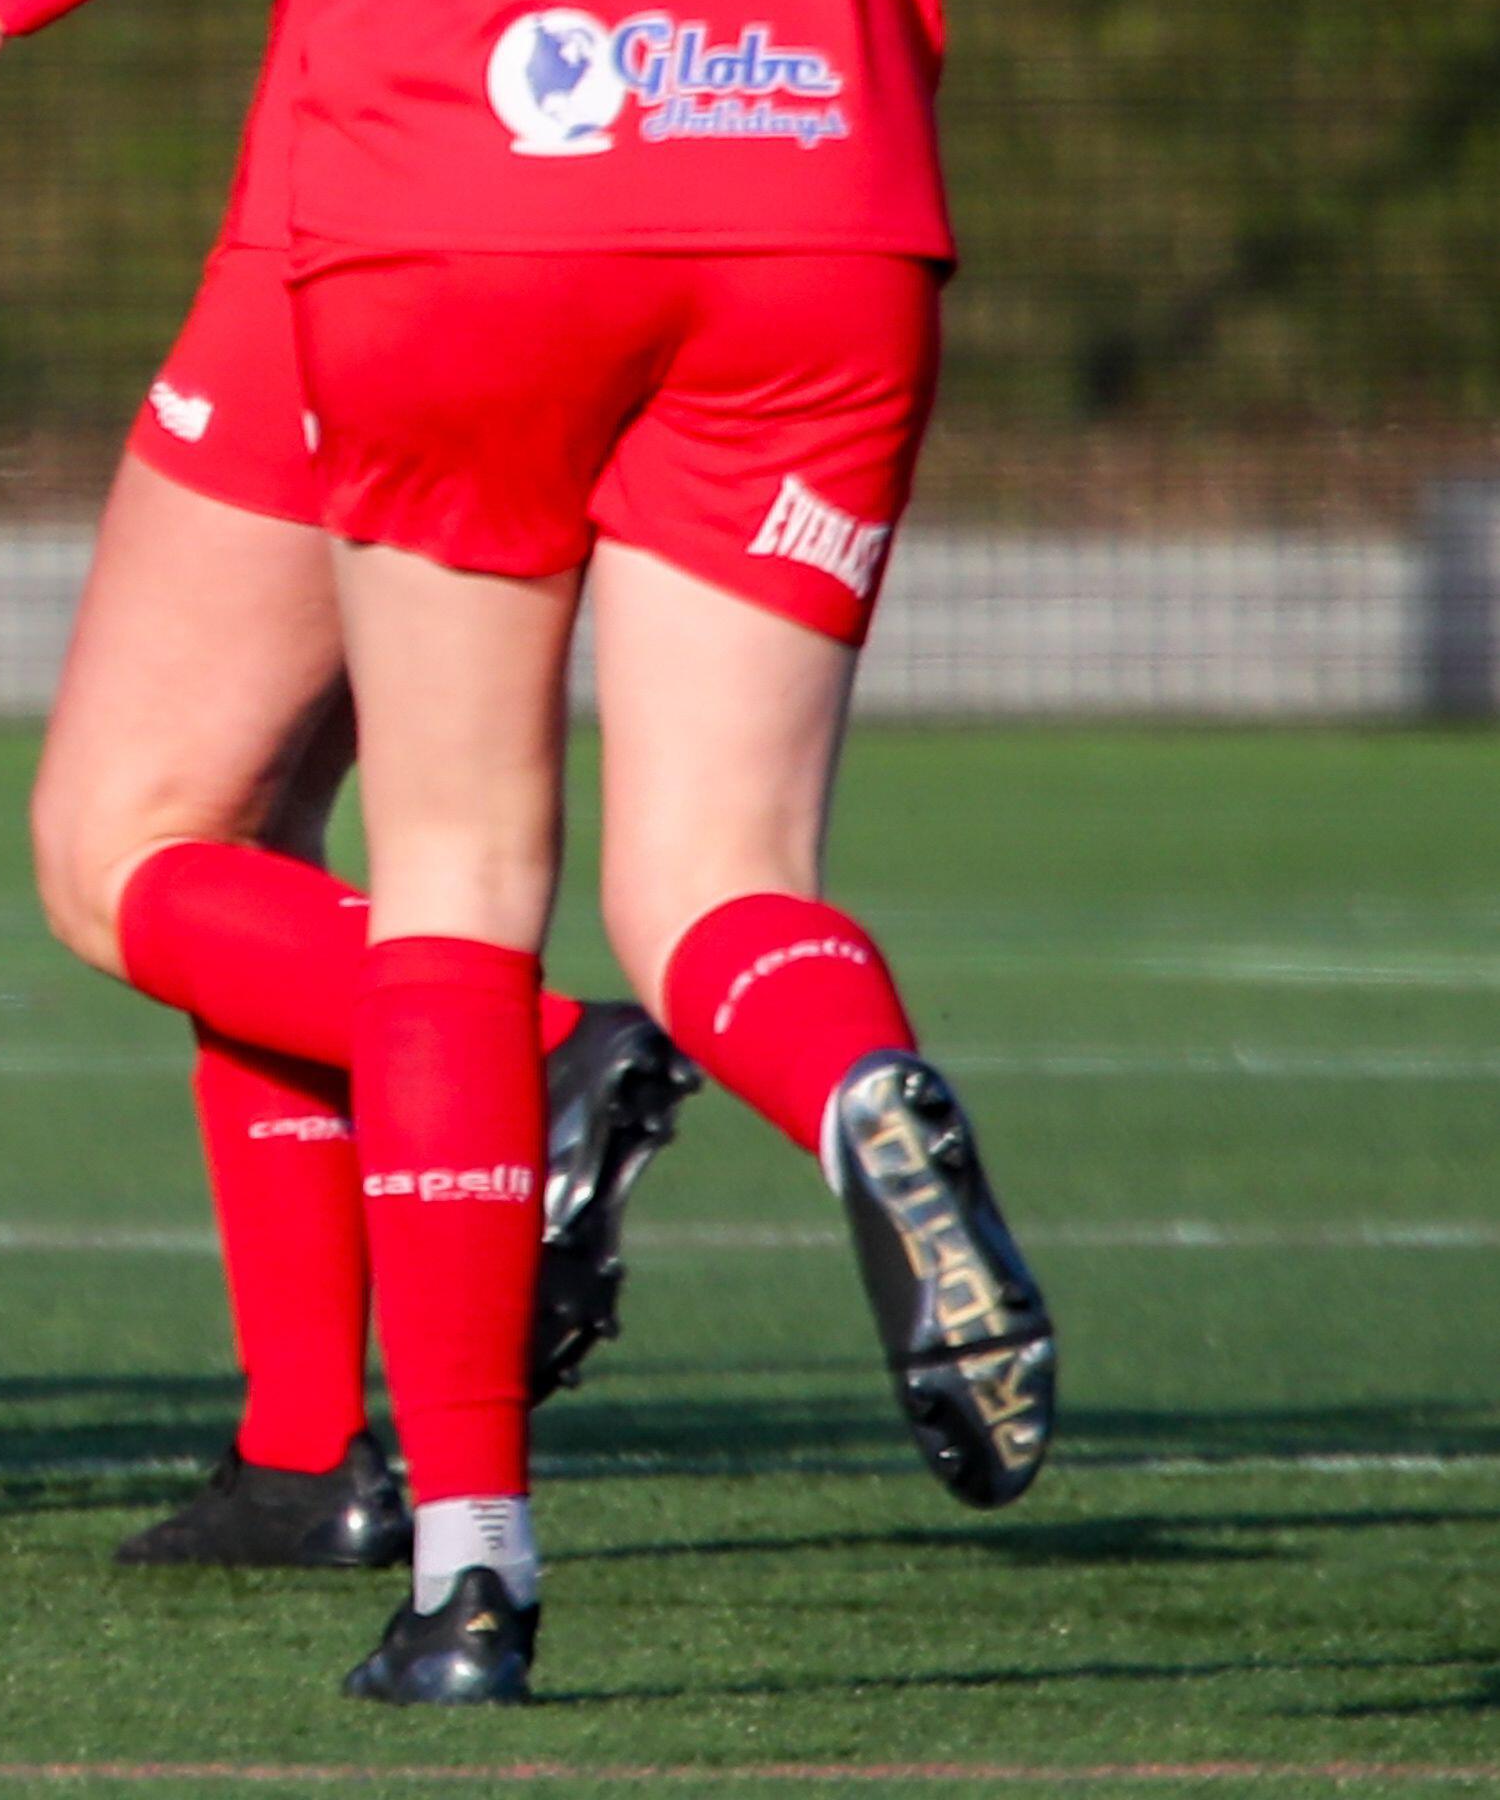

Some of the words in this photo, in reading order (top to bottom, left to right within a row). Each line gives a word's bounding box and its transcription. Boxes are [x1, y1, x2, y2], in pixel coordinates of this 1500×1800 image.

[612, 13, 841, 102] Globe
[643, 98, 848, 147] Holidays
[363, 1163, 533, 1203] capelli
